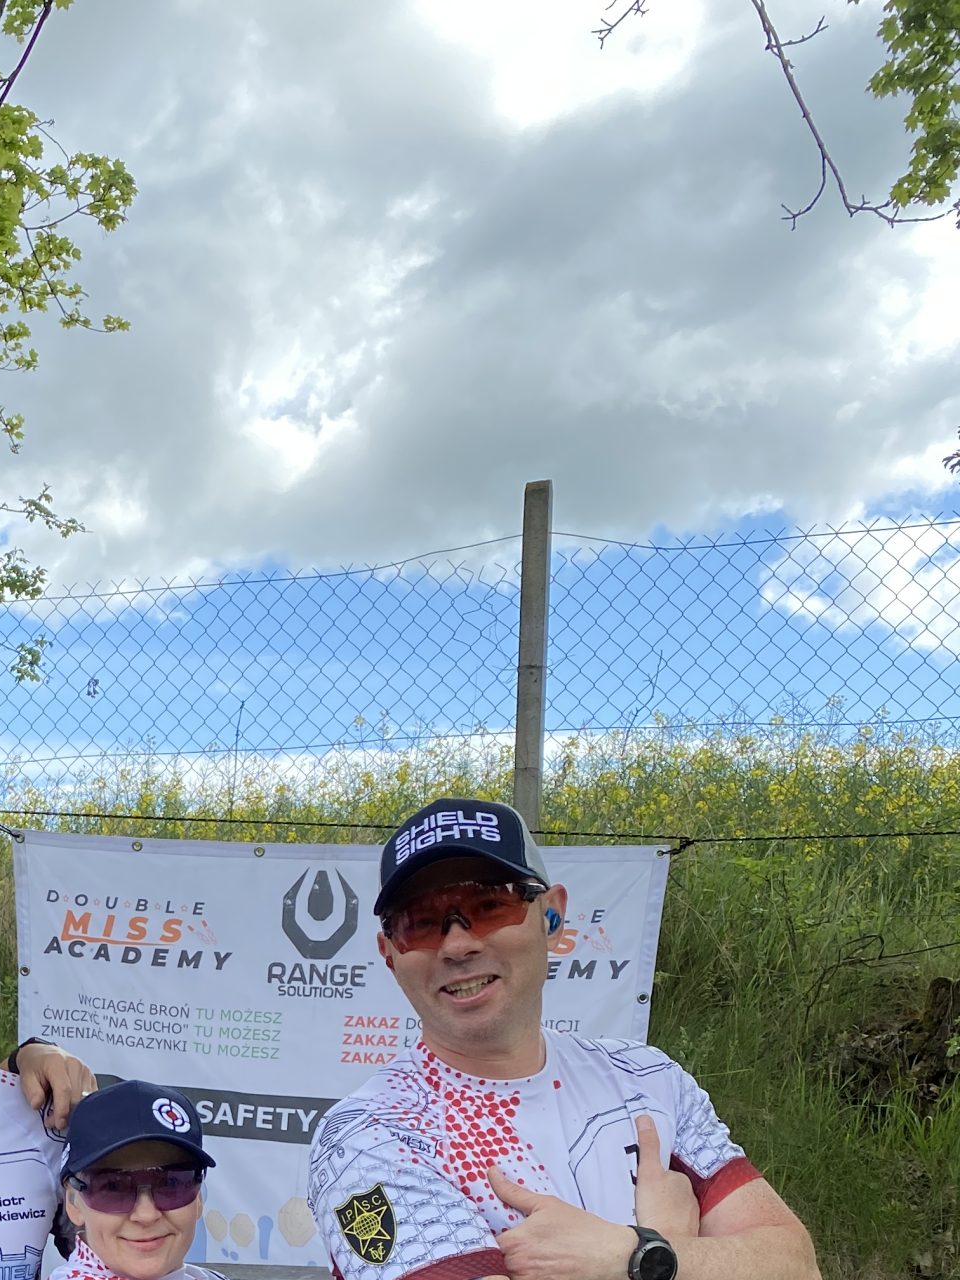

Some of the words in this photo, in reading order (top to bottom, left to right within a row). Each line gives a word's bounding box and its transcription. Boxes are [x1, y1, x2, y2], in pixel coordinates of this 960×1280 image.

[395, 810, 499, 851] SHIELD
[395, 824, 501, 866] SIGHTS
[61, 909, 183, 943] MISS
[43, 936, 233, 970] ACADEMY
[267, 962, 367, 987] RANGE
[278, 985, 353, 999] SOLUTIONS
[43, 1005, 100, 1025] ĆWICZYĆ
[103, 1016, 128, 1030] "NA
[134, 1020, 189, 1034] SUCHO"
[193, 1025, 213, 1038] TU
[219, 1026, 281, 1042] MOŻESZ
[78, 993, 144, 1014] WYCIĄGAĆ
[149, 1003, 190, 1019] BROŃ
[196, 1008, 214, 1021] TU
[220, 1009, 283, 1025] MOŻESZ
[344, 1015, 400, 1029] ZAKAZ
[41, 1024, 104, 1041] ZMIENIAĆ
[106, 1033, 188, 1052] MAGAZYNKI
[192, 1042, 211, 1055] TU
[217, 1043, 280, 1059] MOŻESZ
[342, 1033, 399, 1047] ZAKAZ
[196, 1100, 318, 1132] SAFETY
